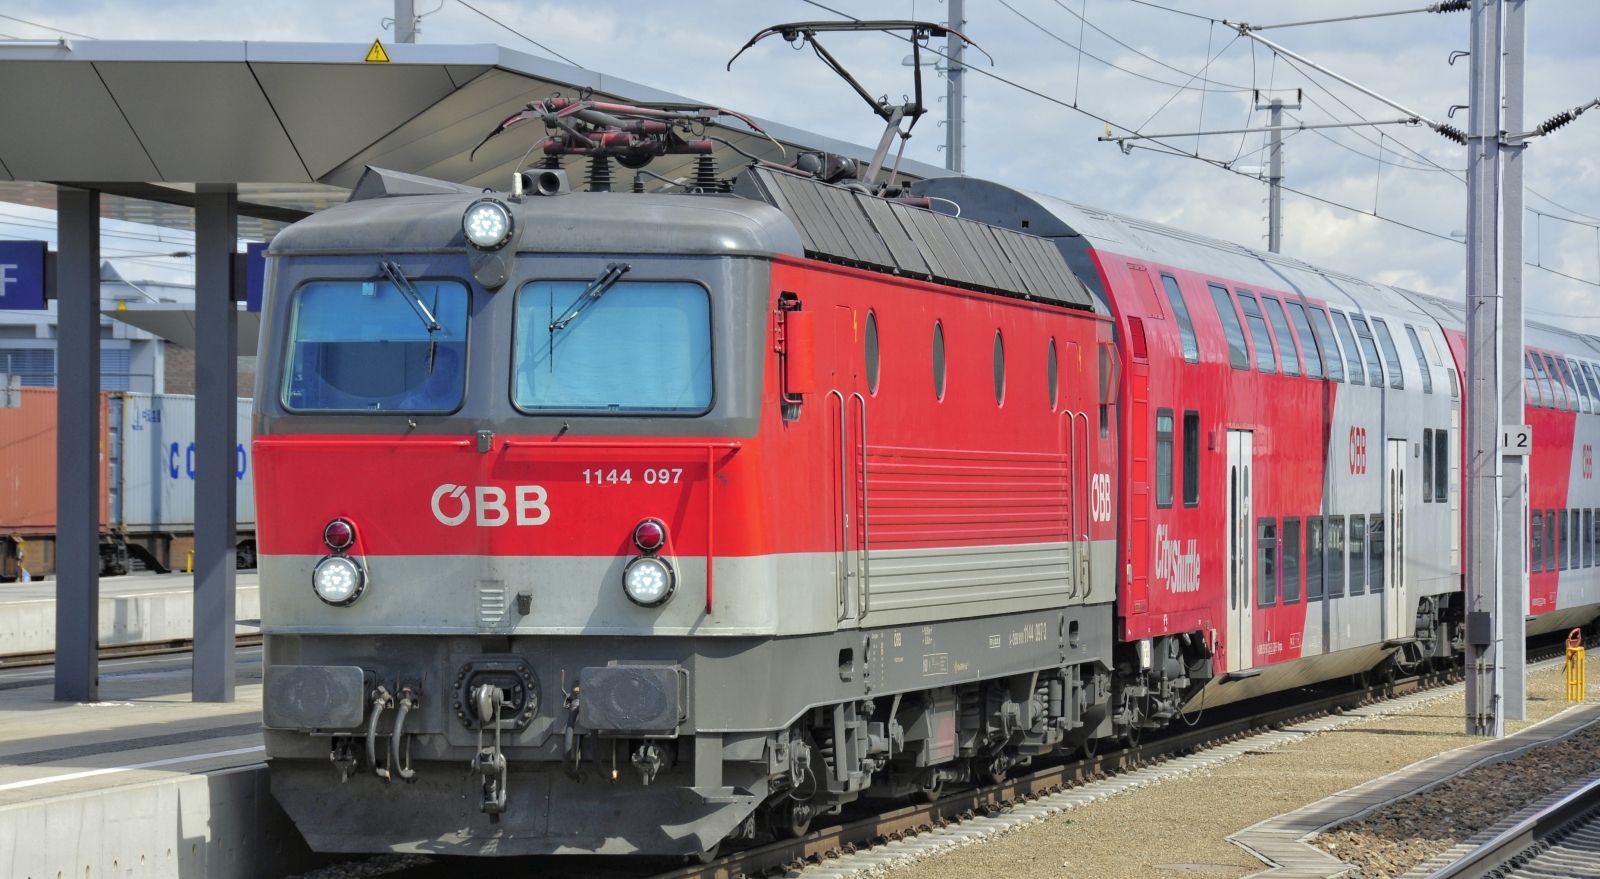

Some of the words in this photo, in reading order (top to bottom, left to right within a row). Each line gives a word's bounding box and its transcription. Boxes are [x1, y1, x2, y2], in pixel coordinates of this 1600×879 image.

[1350, 425, 1366, 475] ÖBB
[582, 468, 633, 485] 1144
[643, 468, 683, 485] 097
[1091, 473, 1111, 522] ÖBB
[431, 483, 550, 526] ÖBB
